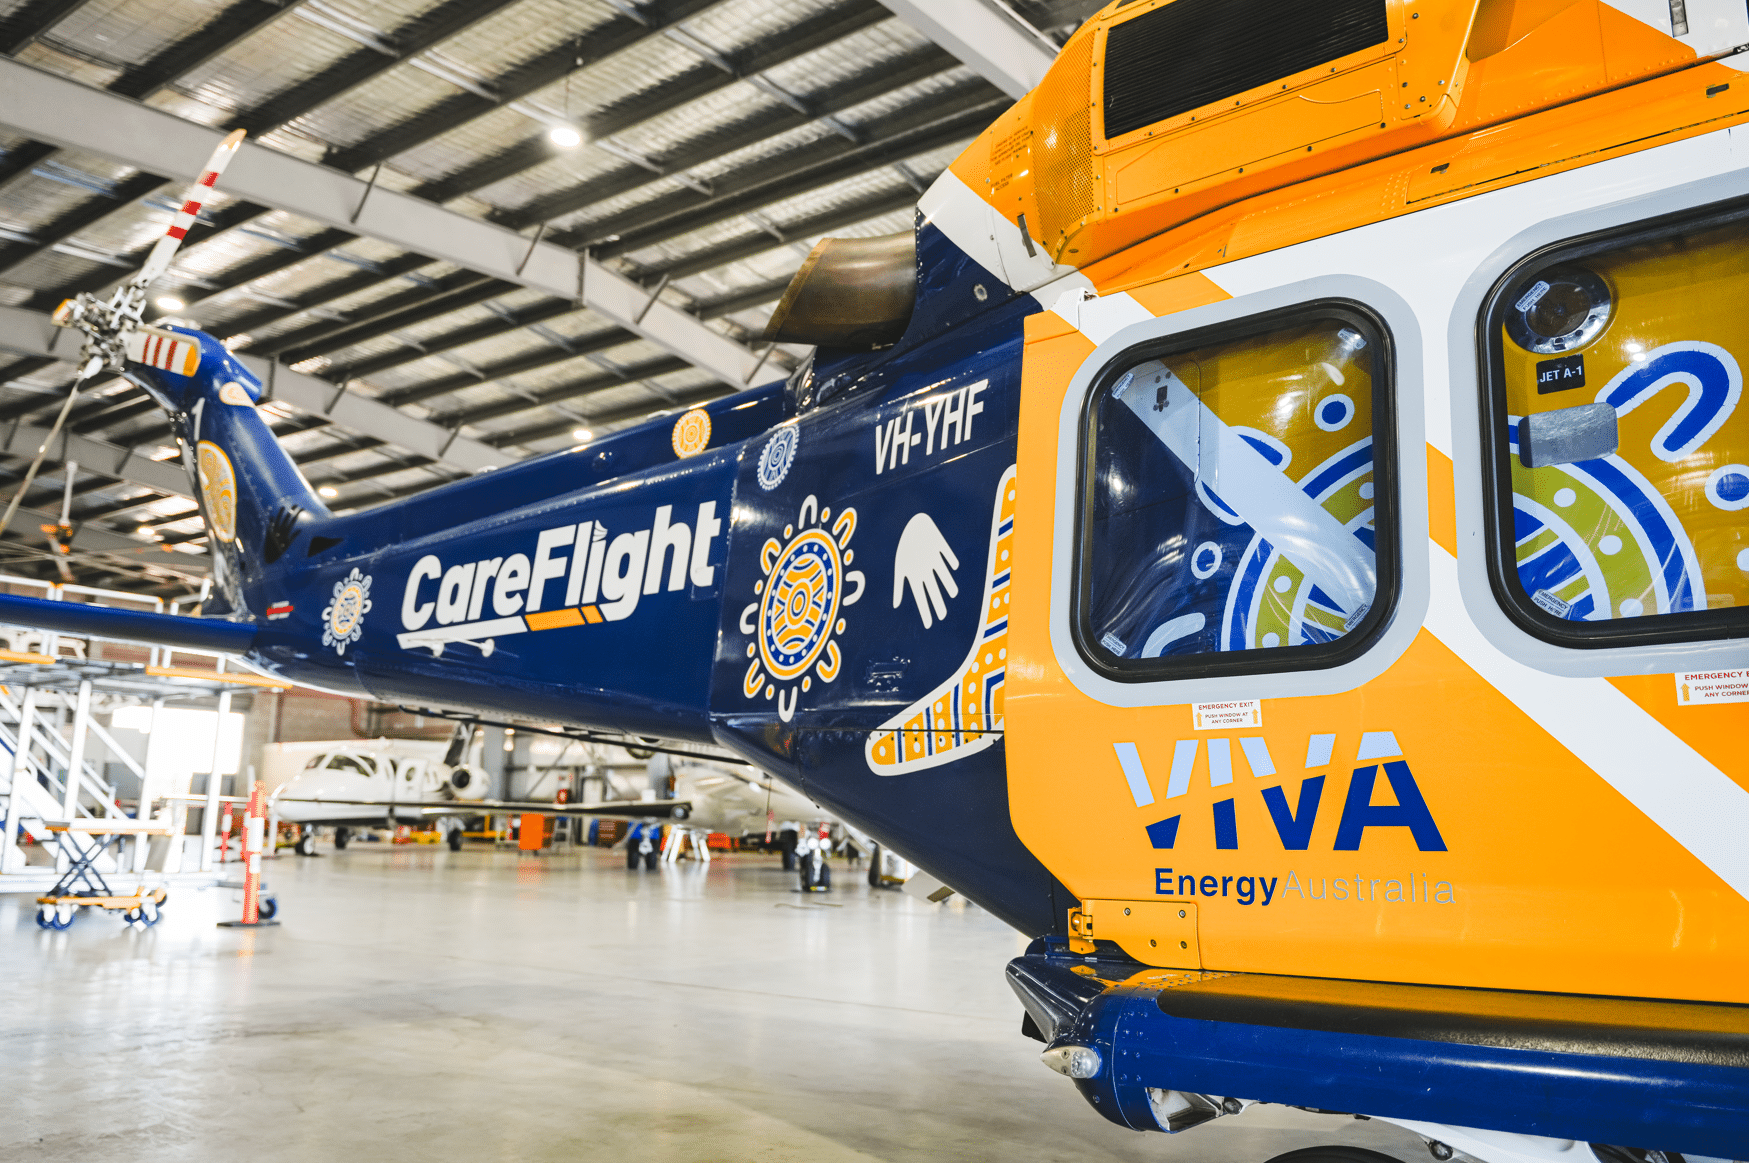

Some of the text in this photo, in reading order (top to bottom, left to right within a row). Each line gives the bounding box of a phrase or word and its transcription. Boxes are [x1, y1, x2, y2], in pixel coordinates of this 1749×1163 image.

[1516, 282, 1542, 307] EMERGENCY
[1540, 365, 1583, 383] JET A-1
[875, 378, 989, 475] VH-YHF
[401, 500, 721, 631] CareFlight
[1533, 596, 1548, 607] PUSH
[1538, 590, 1568, 610] EMERGENCY
[1345, 603, 1368, 629] EMERGENCY
[1684, 671, 1743, 681] EMERGENCY
[1715, 682, 1749, 690] WINDOW
[1198, 702, 1238, 711] EMERGENCY
[1113, 730, 1449, 852] VIVA
